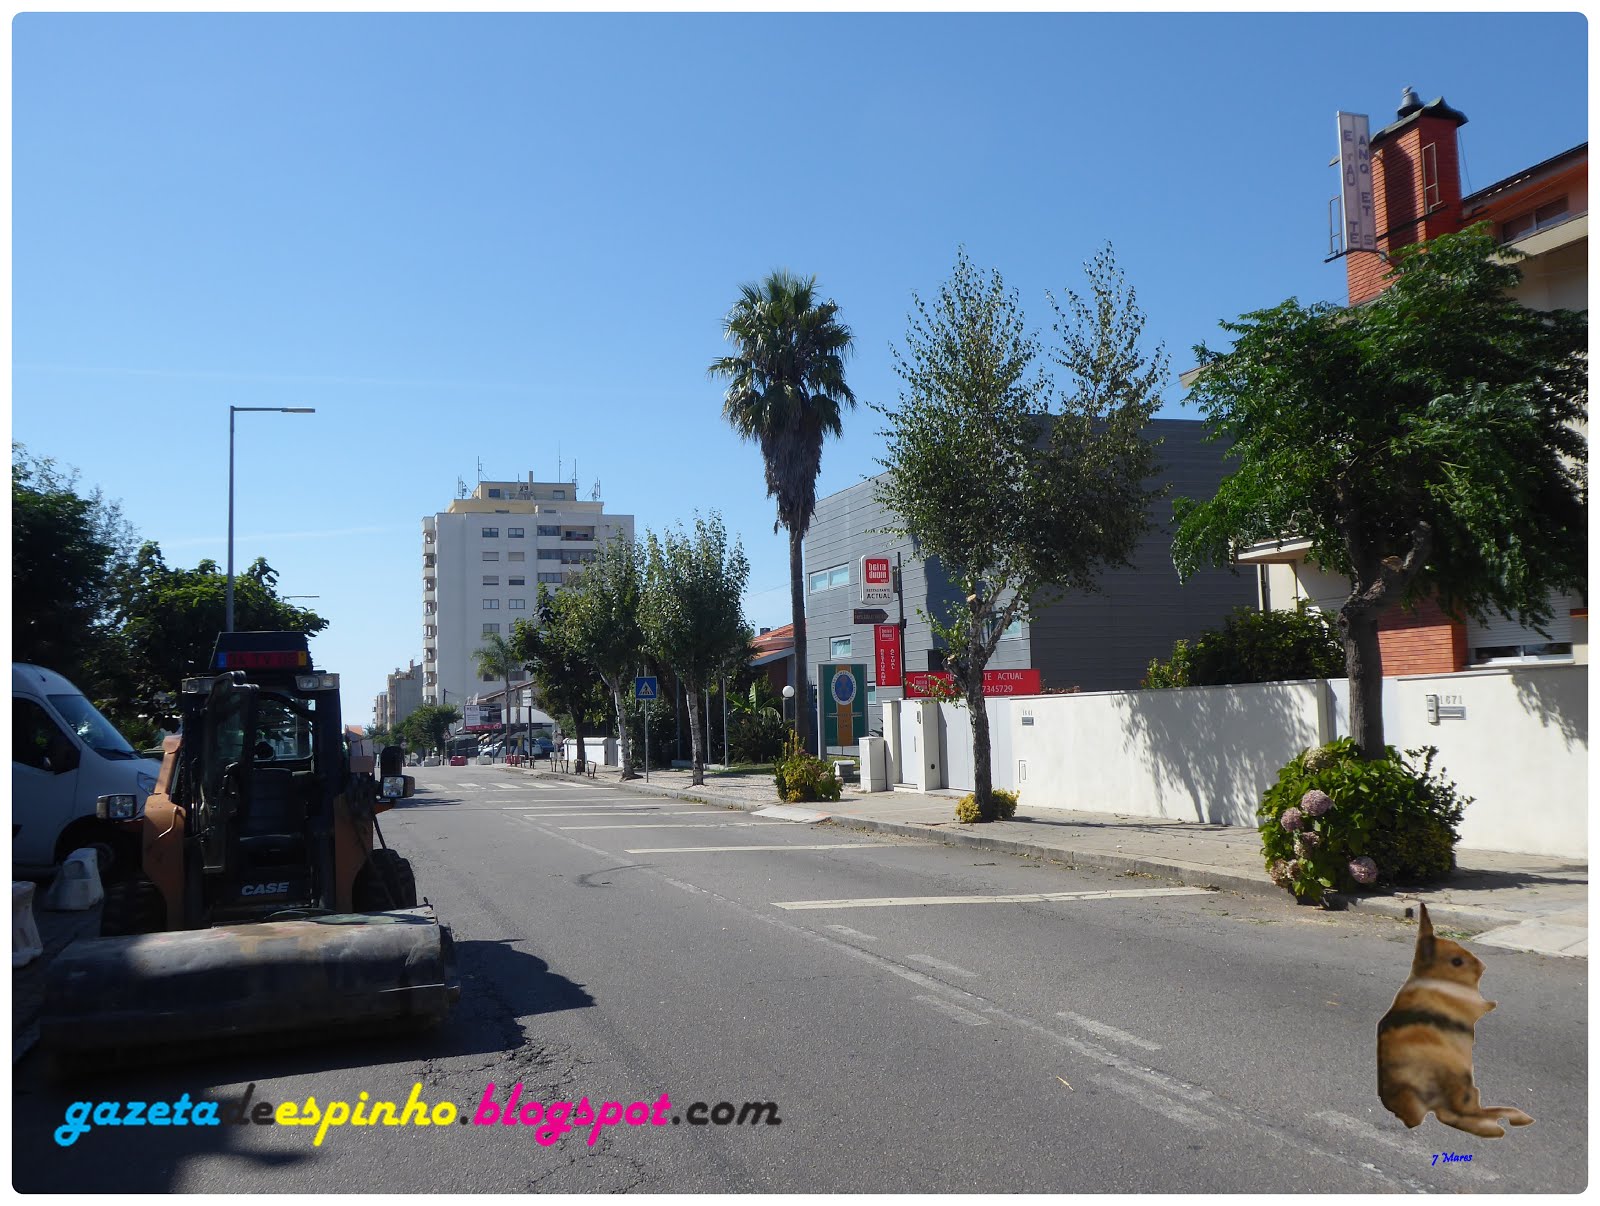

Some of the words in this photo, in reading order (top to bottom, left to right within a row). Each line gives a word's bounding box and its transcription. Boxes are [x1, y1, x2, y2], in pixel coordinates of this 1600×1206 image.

[997, 672, 1023, 680] ACTUAL
[1440, 695, 1463, 704] 1671
[241, 881, 290, 896] CASE
